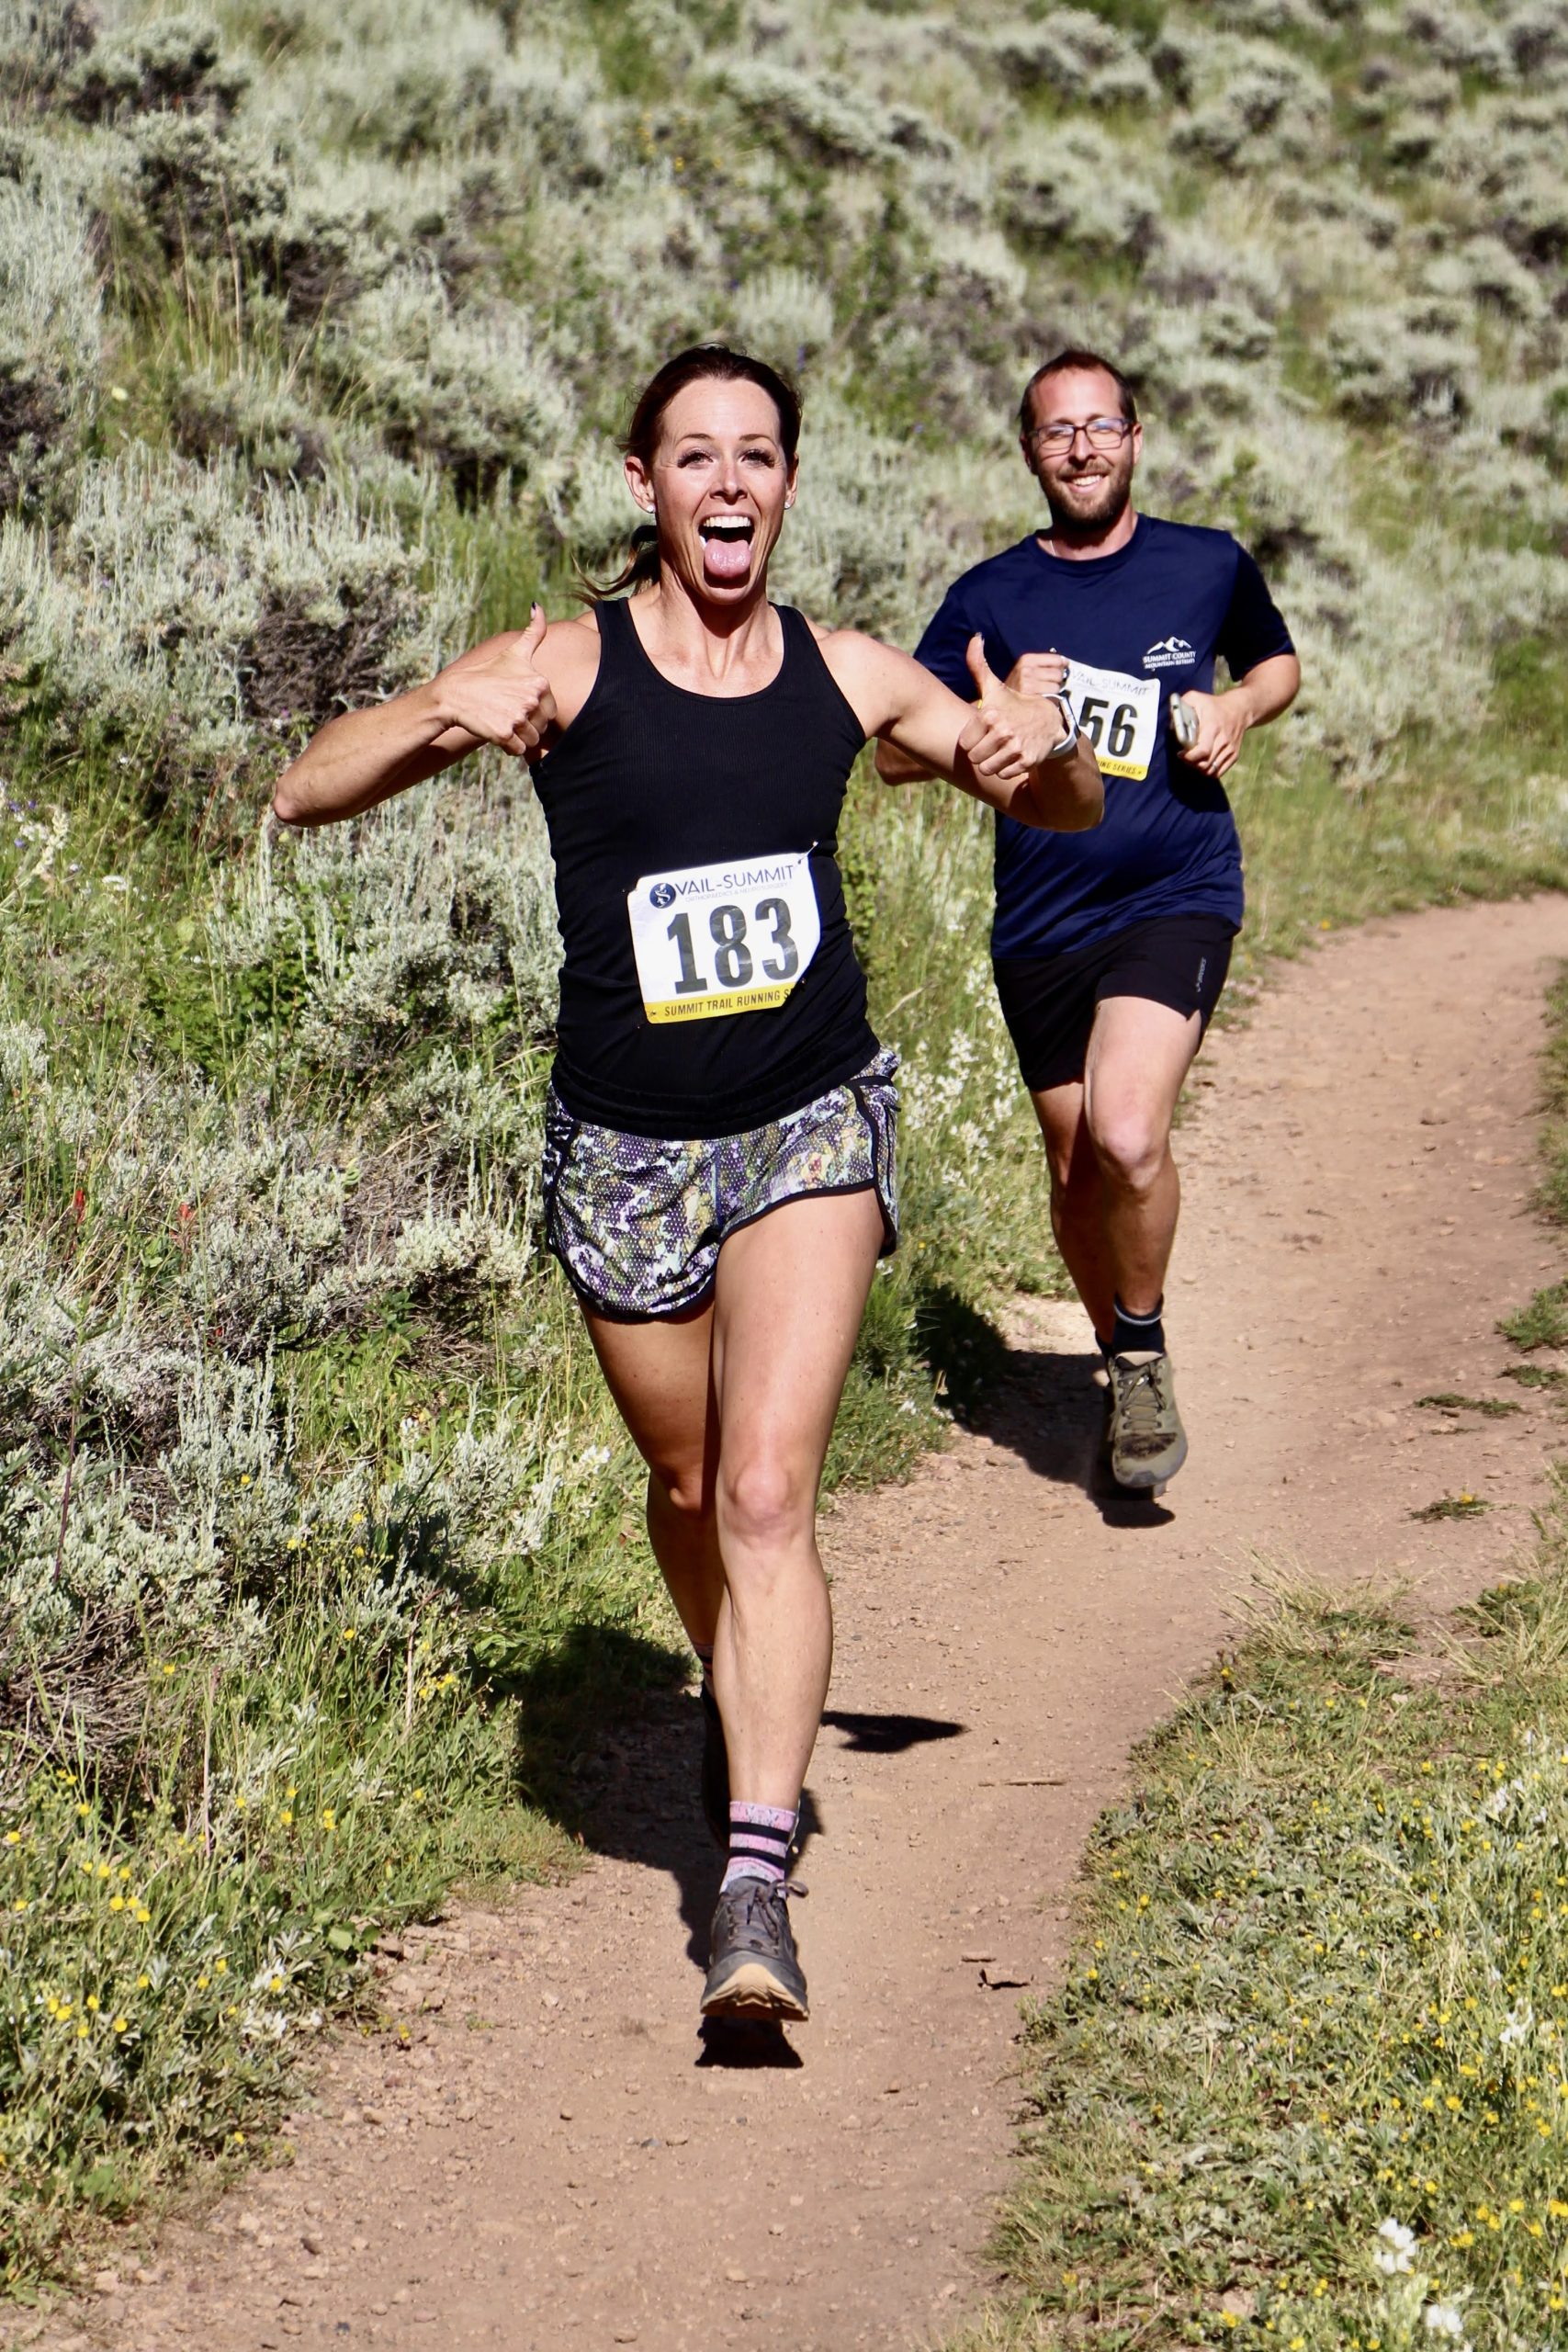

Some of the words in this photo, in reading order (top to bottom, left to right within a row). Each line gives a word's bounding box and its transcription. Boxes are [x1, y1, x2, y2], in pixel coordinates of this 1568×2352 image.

[1143, 653, 1171, 663] SUMMIT
[1172, 650, 1196, 660] COUNTY
[1061, 690, 1137, 757] 56
[675, 865, 794, 895] VAIL-SUMMIT
[666, 898, 799, 994] 183
[664, 1001, 705, 1016] SUMMIT
[706, 998, 734, 1012] TRAIL
[736, 990, 781, 1007] RUNNING
